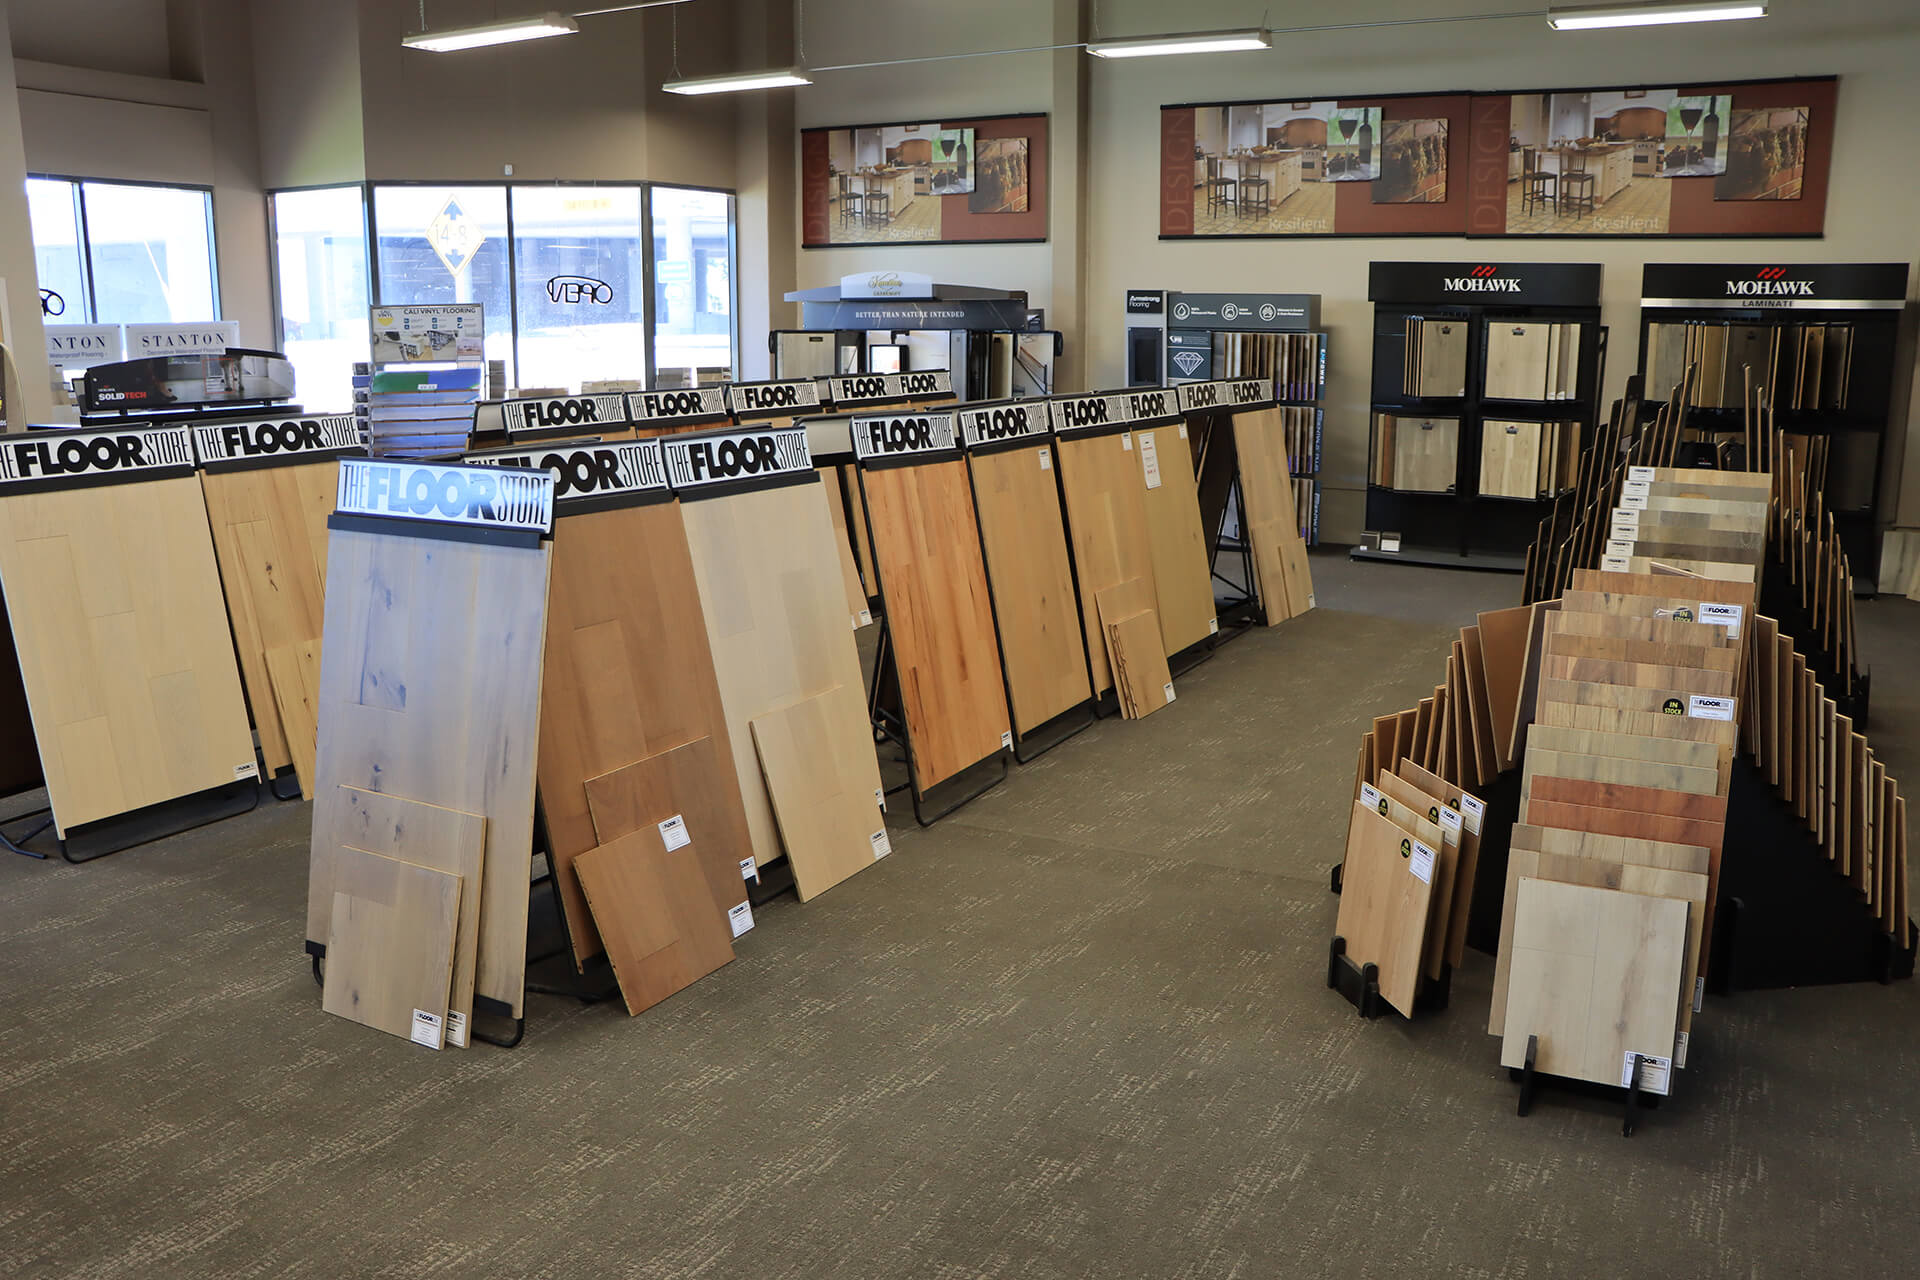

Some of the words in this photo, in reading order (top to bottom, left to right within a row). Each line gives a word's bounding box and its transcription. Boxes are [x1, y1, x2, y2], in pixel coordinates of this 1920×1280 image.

[1166, 109, 1189, 231] DESIGN
[1473, 99, 1505, 229] DESIGN
[1129, 295, 1160, 303] Armstrong
[1444, 278, 1521, 292] MOHAWK
[1726, 280, 1815, 295] MOHAWK
[52, 336, 105, 350] NTON
[142, 333, 225, 348] STANTON
[744, 385, 798, 408] FLOOR
[842, 377, 886, 398] FLOOR
[900, 375, 937, 394] FLOOR
[1187, 384, 1217, 408] FLOOR
[1233, 382, 1262, 403] FLOOR
[506, 403, 525, 430] THE
[523, 399, 599, 427] FLOOR
[597, 396, 624, 422] STORE
[630, 395, 647, 419] THE
[644, 392, 704, 417] FLOOR
[701, 389, 724, 413] STORE
[1063, 398, 1108, 427] FLOOR
[1130, 393, 1167, 418] FLOOR
[199, 427, 225, 460] THE
[222, 420, 326, 457] FLOOR
[322, 416, 359, 448] STORE
[855, 421, 872, 455] THE
[869, 418, 933, 453] FLOOR
[930, 416, 954, 448] STORE
[975, 408, 1029, 440] FLOOR
[0, 444, 17, 480] HE
[14, 435, 148, 477] FLOOR
[144, 430, 191, 465] STORE
[667, 443, 694, 484] THE
[688, 436, 781, 481] FLOOR
[776, 432, 811, 470] STORE
[499, 449, 625, 497] OOR
[619, 445, 664, 488] STORE
[343, 463, 368, 509] THE
[368, 466, 496, 520] FLOOR
[498, 474, 551, 526] STORE
